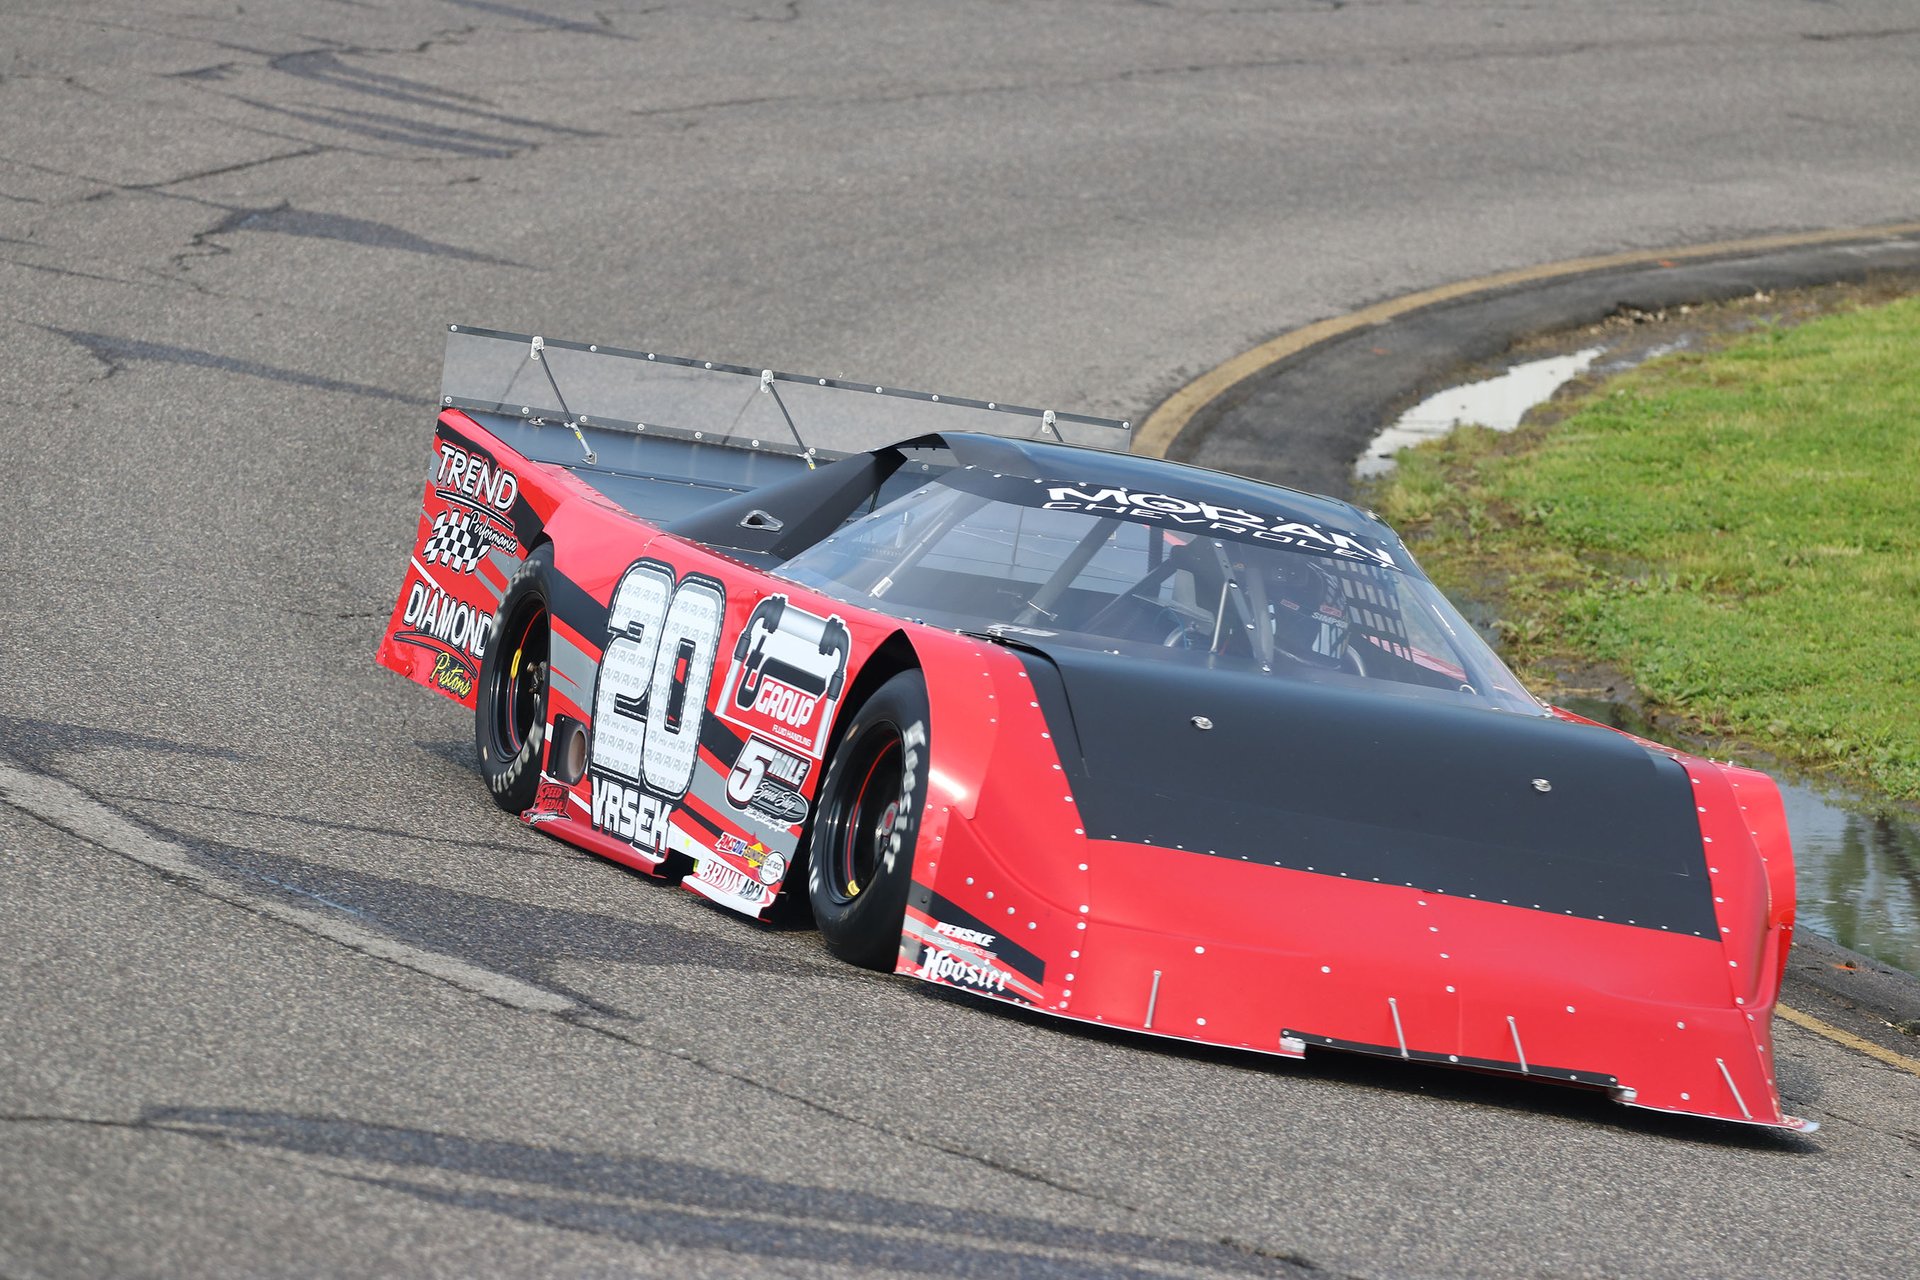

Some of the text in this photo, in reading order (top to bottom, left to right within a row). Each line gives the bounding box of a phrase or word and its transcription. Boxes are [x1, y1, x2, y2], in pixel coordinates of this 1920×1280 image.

[438, 442, 518, 512] TREND
[469, 511, 518, 555] Performance
[1042, 502, 1403, 572] CHEVROLET
[1047, 487, 1395, 567] MORAN
[402, 580, 493, 660] DIAMOND
[430, 652, 472, 699] Pistons
[590, 557, 726, 801] 20
[755, 681, 815, 728] GROUP
[728, 738, 809, 803] 5 MILE
[590, 775, 672, 857] VRSEK
[717, 833, 746, 856] AMSOIL
[933, 921, 996, 947] PENSKE
[914, 946, 1012, 992] Hoosier
